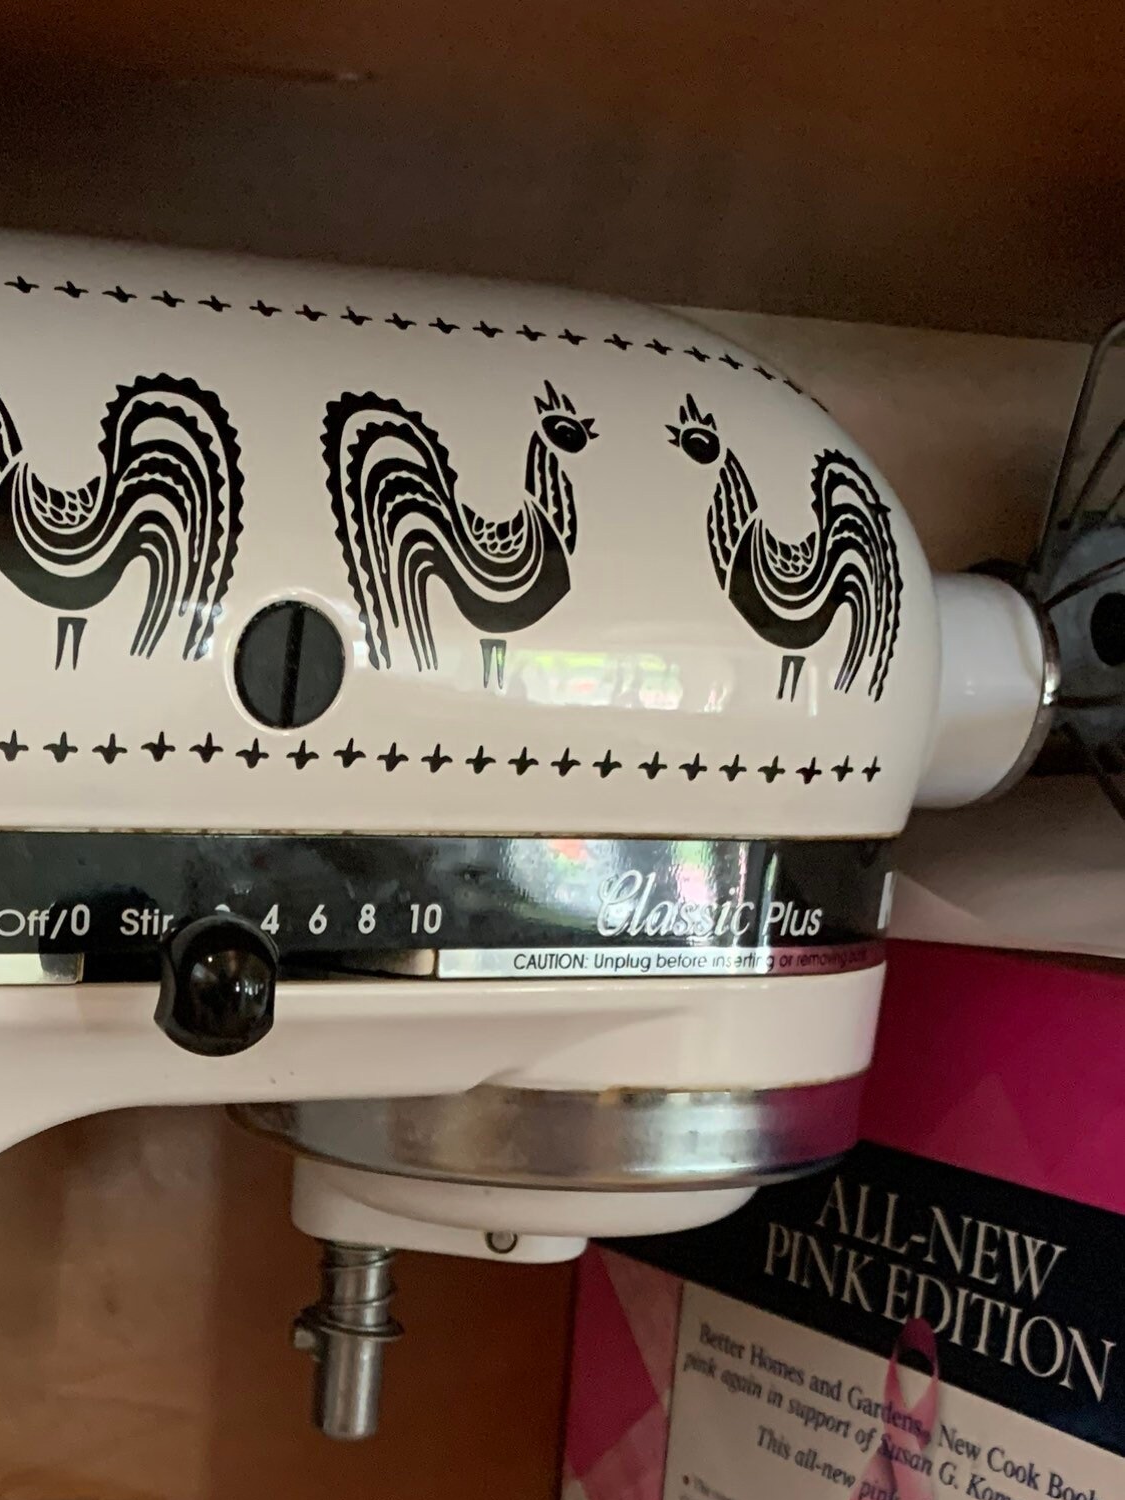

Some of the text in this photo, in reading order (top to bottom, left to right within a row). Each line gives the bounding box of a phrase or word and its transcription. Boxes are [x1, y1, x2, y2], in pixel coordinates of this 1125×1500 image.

[119, 907, 175, 936] Stir
[260, 904, 280, 935] 4
[308, 905, 327, 934] 6
[358, 905, 376, 934] 8
[410, 904, 442, 934] 10
[596, 869, 824, 938] Classic Plus
[513, 952, 589, 970] CAUTION:
[594, 952, 651, 974] Unplug
[655, 953, 708, 971] before
[778, 955, 793, 968] or
[815, 1175, 1067, 1301] ALL-NEW
[764, 1221, 1116, 1403] PINK EDITION
[749, 1343, 804, 1385] Homes
[808, 1375, 842, 1401] and
[936, 1420, 980, 1460] New
[986, 1446, 1039, 1490] Cook
[757, 1424, 790, 1459] This
[793, 1447, 855, 1487] all-new
[766, 1389, 783, 1408] in
[786, 1398, 851, 1437] support
[854, 1426, 877, 1453] of
[877, 1433, 932, 1475] Susan
[938, 1460, 958, 1489] G.
